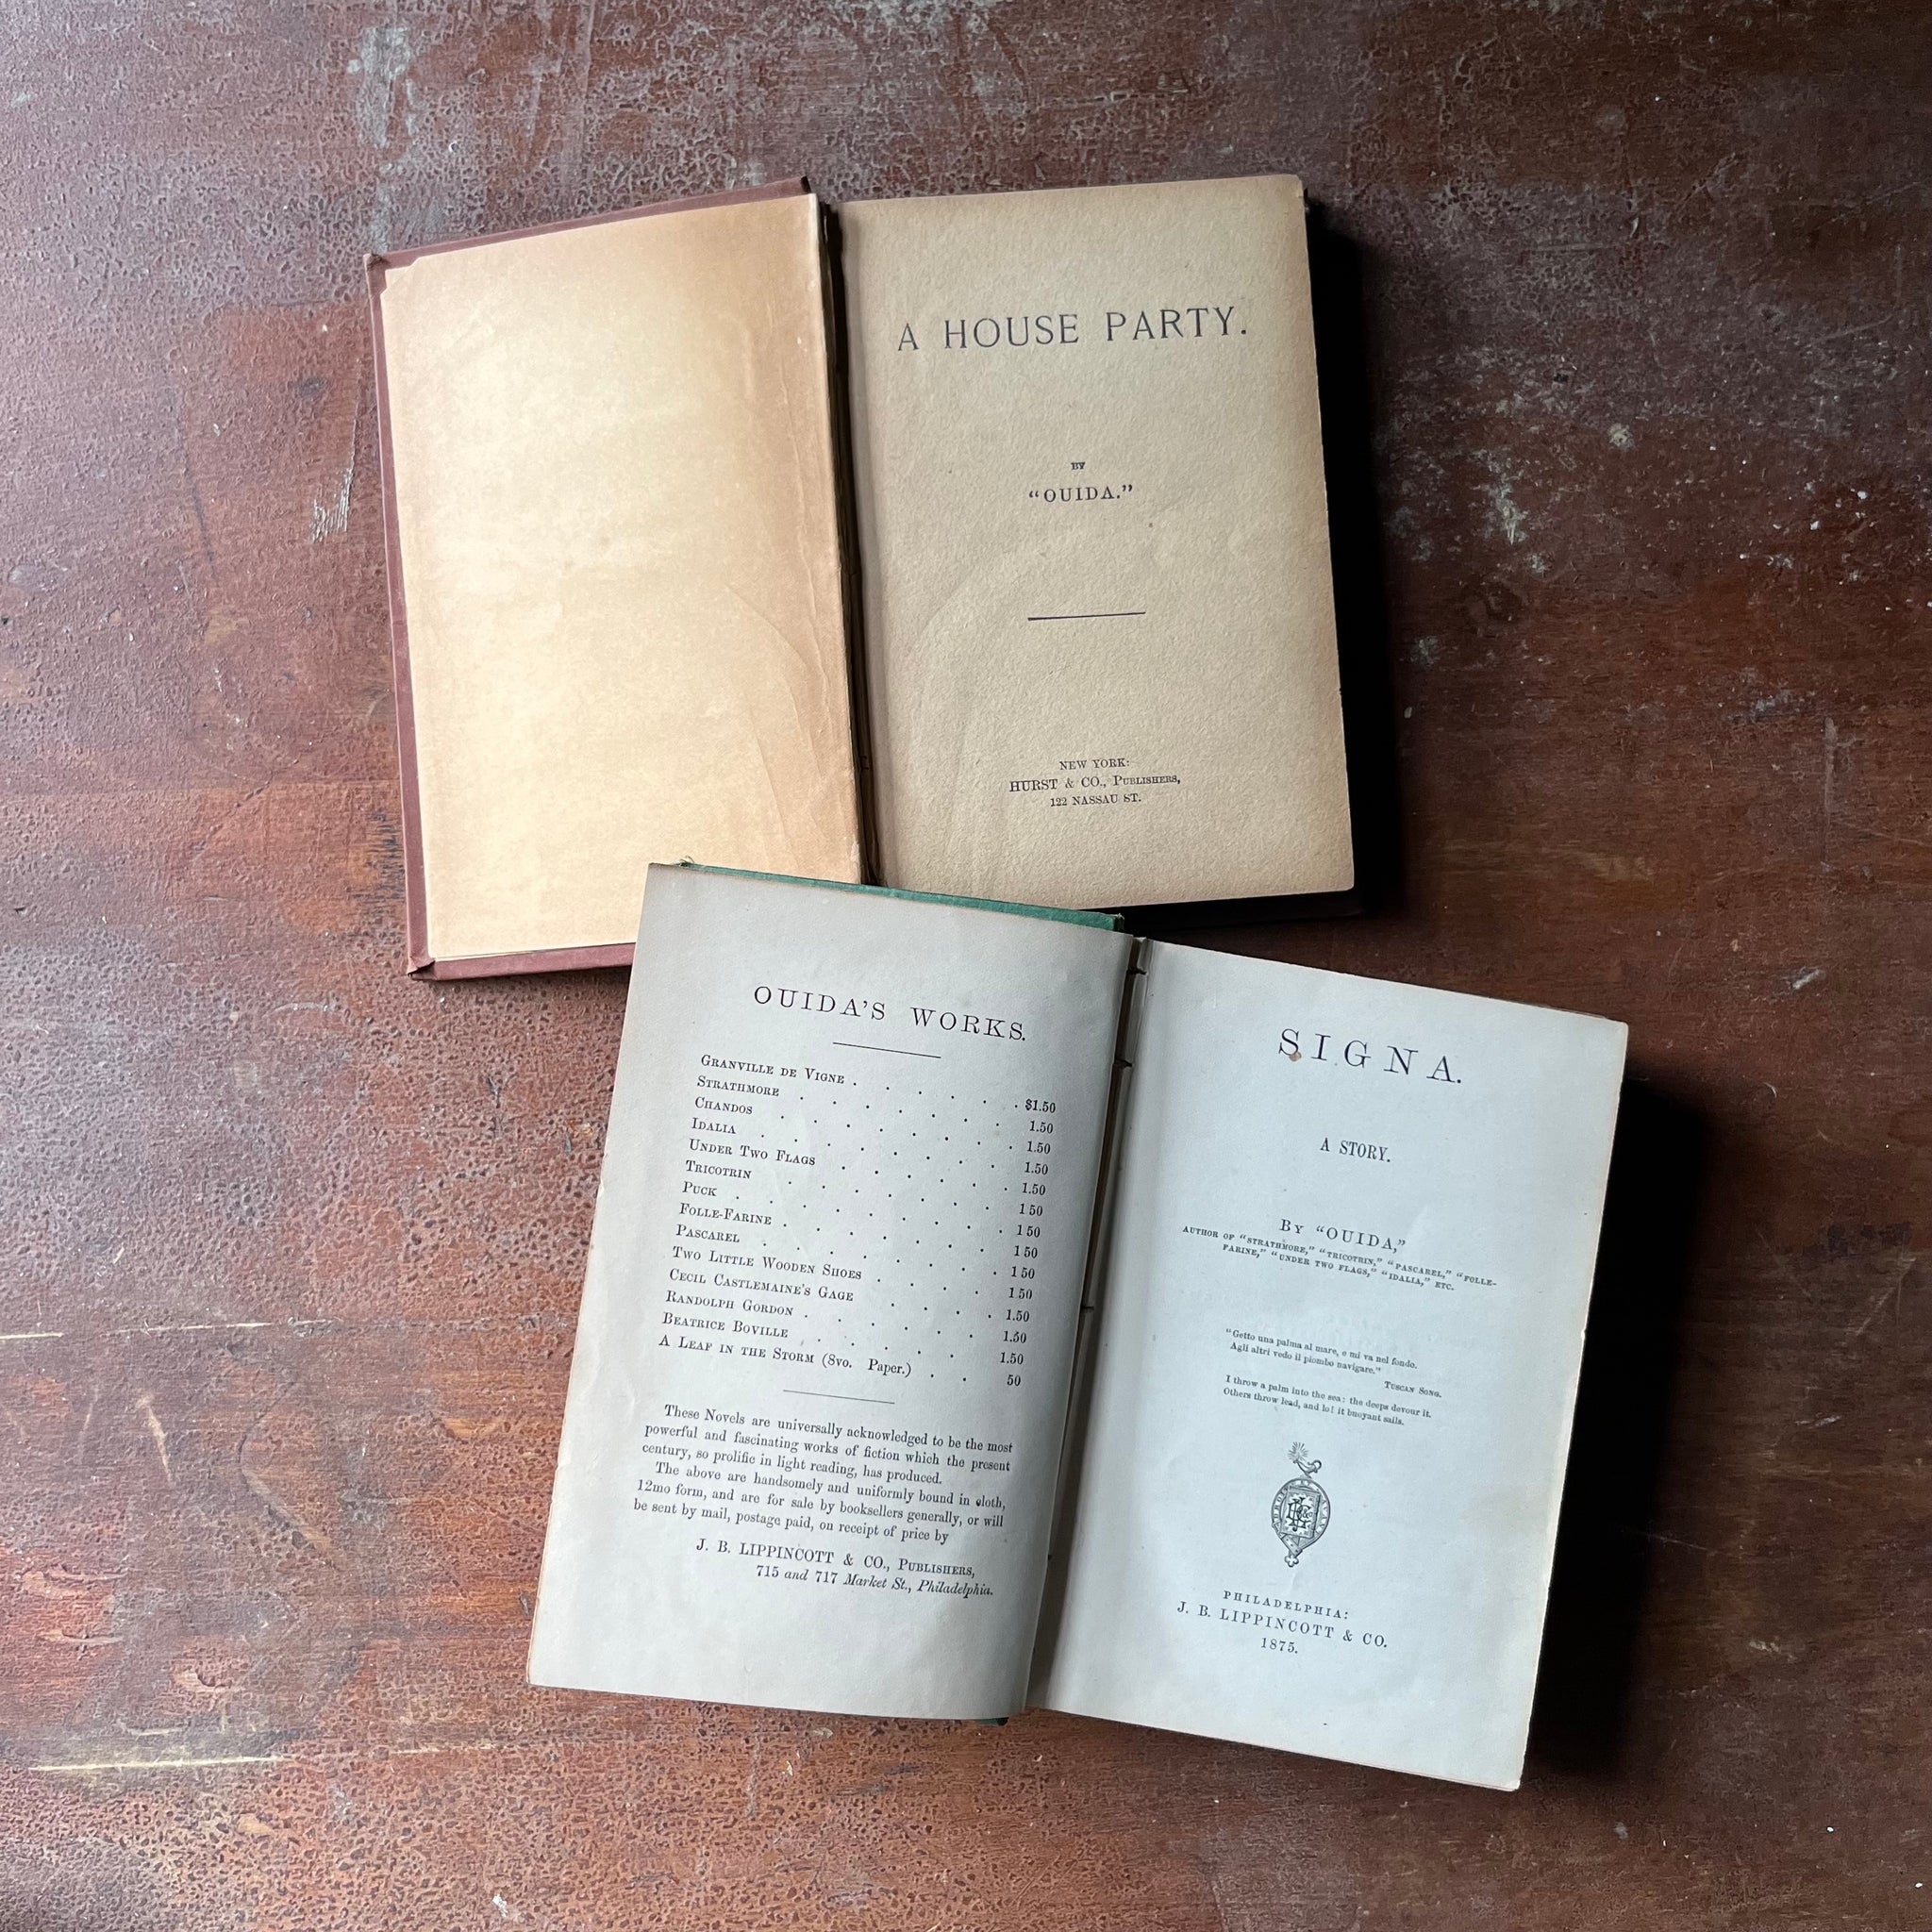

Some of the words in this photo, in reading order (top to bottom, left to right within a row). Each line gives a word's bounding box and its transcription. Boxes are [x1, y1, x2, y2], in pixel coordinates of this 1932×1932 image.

[897, 322, 920, 352] A
[944, 313, 1079, 349] HOUSE
[1106, 306, 1247, 341] PARTY.
[1070, 461, 1086, 471] BY
[1058, 759, 1088, 771] NEW
[1091, 758, 1130, 769] YORK:
[1008, 778, 1058, 792] HURST
[1064, 777, 1074, 789] &
[1080, 775, 1107, 789] CO.,
[1112, 774, 1181, 787] PUBLISHERS,
[1050, 796, 1068, 808] 122
[1072, 793, 1119, 806] NASSAU
[1123, 792, 1142, 803] ST.
[754, 986, 885, 1021] OUIDA'S
[909, 1007, 1026, 1041] WORKS.
[1277, 1028, 1462, 1084] SIGNA.
[701, 1054, 774, 1075] GRANVILLE
[779, 1067, 797, 1078] DE
[804, 1067, 845, 1085] VIGNE
[1024, 1098, 1057, 1114] $1.50
[696, 1074, 779, 1097] STRATHMORE
[1029, 1120, 1054, 1135] 1.50
[694, 1096, 753, 1115] CHANDOS
[1026, 1141, 1051, 1155] 1.50
[691, 1117, 737, 1135] IDALIA
[1024, 1161, 1049, 1175] 1.50
[1320, 1137, 1330, 1153] A
[1339, 1140, 1391, 1163] STORY.
[685, 1159, 752, 1179] TRICOTRIN
[689, 1138, 733, 1156] UNDER
[740, 1144, 769, 1160] TWO
[774, 1149, 816, 1166] FLAGS
[1022, 1182, 1046, 1196] 1.50
[681, 1180, 718, 1197] PUCK
[678, 1202, 772, 1225] FOLLE-FARINE
[1278, 1218, 1305, 1235] BY
[675, 1224, 741, 1243] PASCAREL
[673, 1245, 702, 1261] TWO
[708, 1249, 755, 1267] LITTLE
[761, 1256, 816, 1274] WOODEN
[822, 1263, 862, 1280] SHOES
[665, 1290, 734, 1309] RANDOLPH
[742, 1299, 794, 1316] GORDON
[669, 1268, 707, 1284] CECIL
[713, 1274, 811, 1296] CASTLEMAINE'S
[818, 1286, 854, 1302] GAGE
[1006, 1308, 1030, 1323] 1.50
[661, 1311, 725, 1331] BEATRICE
[732, 1320, 789, 1339] BOVILLE
[999, 1351, 1024, 1365] 1.50
[1229, 1341, 1249, 1353] Agli
[1251, 1345, 1271, 1357] altri
[1273, 1351, 1292, 1359] vedo
[1303, 1356, 1335, 1367] piombo
[658, 1334, 671, 1347] A
[677, 1336, 713, 1352] LEAF
[719, 1343, 734, 1355] IN
[741, 1346, 767, 1358] THE
[772, 1347, 815, 1364] STORM
[822, 1353, 853, 1369] (8vo.
[867, 1357, 911, 1378] Paper.)
[1007, 1374, 1022, 1387] 50
[1391, 1357, 1418, 1370] fondo.
[1233, 1376, 1258, 1388] throw
[1268, 1383, 1290, 1393] palm
[1291, 1387, 1309, 1397] into
[1254, 1392, 1279, 1404] throw
[1280, 1396, 1301, 1409] lead,
[1384, 1380, 1415, 1393] TUSCAN
[1418, 1387, 1442, 1398] SONG.
[664, 1404, 700, 1420] These
[704, 1407, 745, 1425] Novels
[777, 1418, 843, 1440] universally
[846, 1425, 928, 1448] acknowledged
[965, 1437, 984, 1451] the
[987, 1442, 1013, 1454] most
[641, 1444, 691, 1460] century,
[712, 1450, 756, 1465] prolific
[776, 1455, 807, 1473] light
[809, 1460, 858, 1479] reading,
[862, 1464, 883, 1478] has
[886, 1469, 942, 1485] produced.
[644, 1424, 698, 1439] powerful
[704, 1429, 727, 1442] and
[733, 1431, 800, 1454] fascinating
[804, 1441, 839, 1455] works
[863, 1445, 900, 1461] fiction
[905, 1450, 940, 1465] which
[946, 1454, 965, 1468] the
[970, 1459, 1010, 1473] present
[637, 1478, 671, 1494] 12mo
[675, 1483, 708, 1501] form,
[711, 1488, 735, 1501] and
[791, 1496, 814, 1509] sale
[840, 1500, 904, 1519] booksellers
[907, 1510, 962, 1527] generally,
[983, 1514, 1004, 1527] will
[655, 1460, 679, 1475] The
[686, 1465, 722, 1480] above
[753, 1472, 824, 1495] handsomely
[827, 1481, 850, 1494] and
[857, 1484, 915, 1505] uniformly
[919, 1489, 954, 1505] bound
[975, 1494, 1006, 1512] cloth,
[651, 1504, 677, 1514] sent
[701, 1507, 731, 1524] mail,
[735, 1512, 781, 1528] postage
[784, 1515, 814, 1532] paid,
[838, 1522, 879, 1540] receipt
[900, 1526, 930, 1542] price
[695, 1538, 708, 1552] J.
[717, 1540, 731, 1554] B.
[739, 1541, 835, 1564] LIPPINCOTT
[842, 1553, 854, 1567] &
[863, 1555, 891, 1573] CO.,
[897, 1557, 975, 1579] PUBLISHERS,
[756, 1564, 779, 1578] 715
[784, 1569, 809, 1581] and
[815, 1570, 839, 1585] 717
[842, 1573, 888, 1589] Market
[891, 1576, 912, 1594] St.,
[916, 1579, 993, 1599] Philadelphia.
[1223, 1590, 1348, 1620] PHILADELPHIA:
[1176, 1600, 1189, 1614] J.
[1197, 1604, 1211, 1618] B.
[1219, 1607, 1335, 1639] LIPPINCOTT
[1342, 1629, 1353, 1642] &
[1362, 1632, 1388, 1648] CO.
[1260, 1637, 1298, 1655] 1875.
